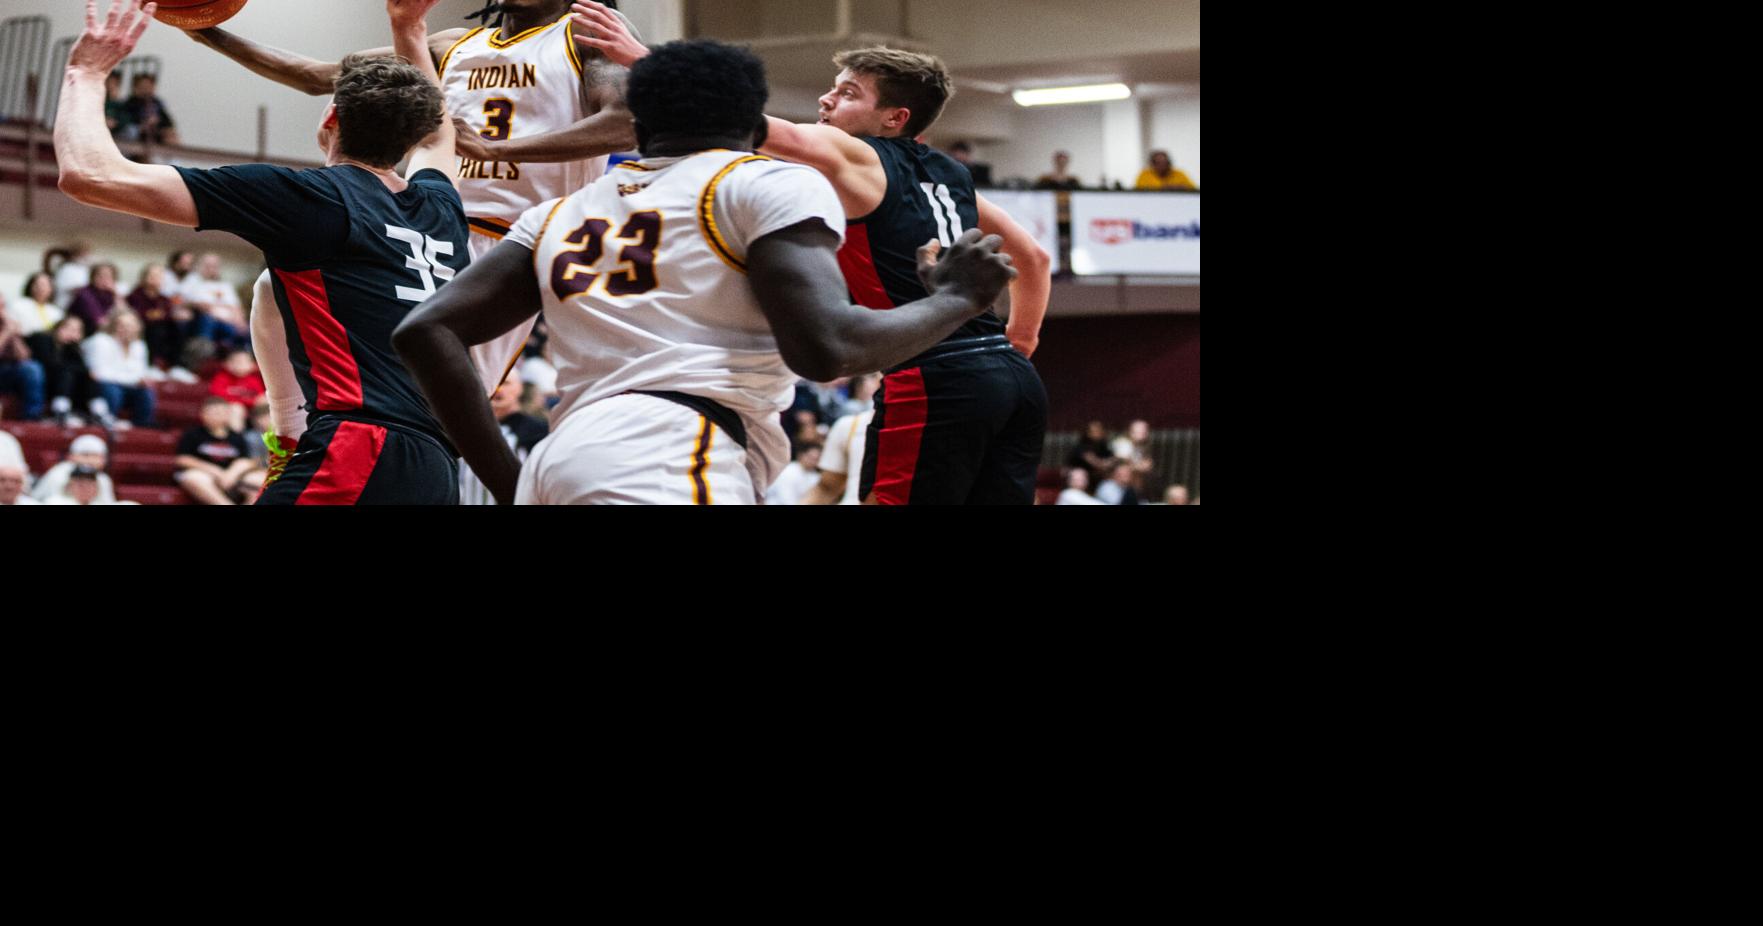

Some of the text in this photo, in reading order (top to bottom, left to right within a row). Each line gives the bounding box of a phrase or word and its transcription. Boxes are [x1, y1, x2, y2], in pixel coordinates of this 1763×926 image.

[467, 63, 537, 91] INDIAN
[480, 97, 516, 141] 3
[457, 157, 520, 181] HILLS
[919, 182, 964, 248] 11
[384, 223, 457, 303] 35
[549, 208, 664, 303] 23
